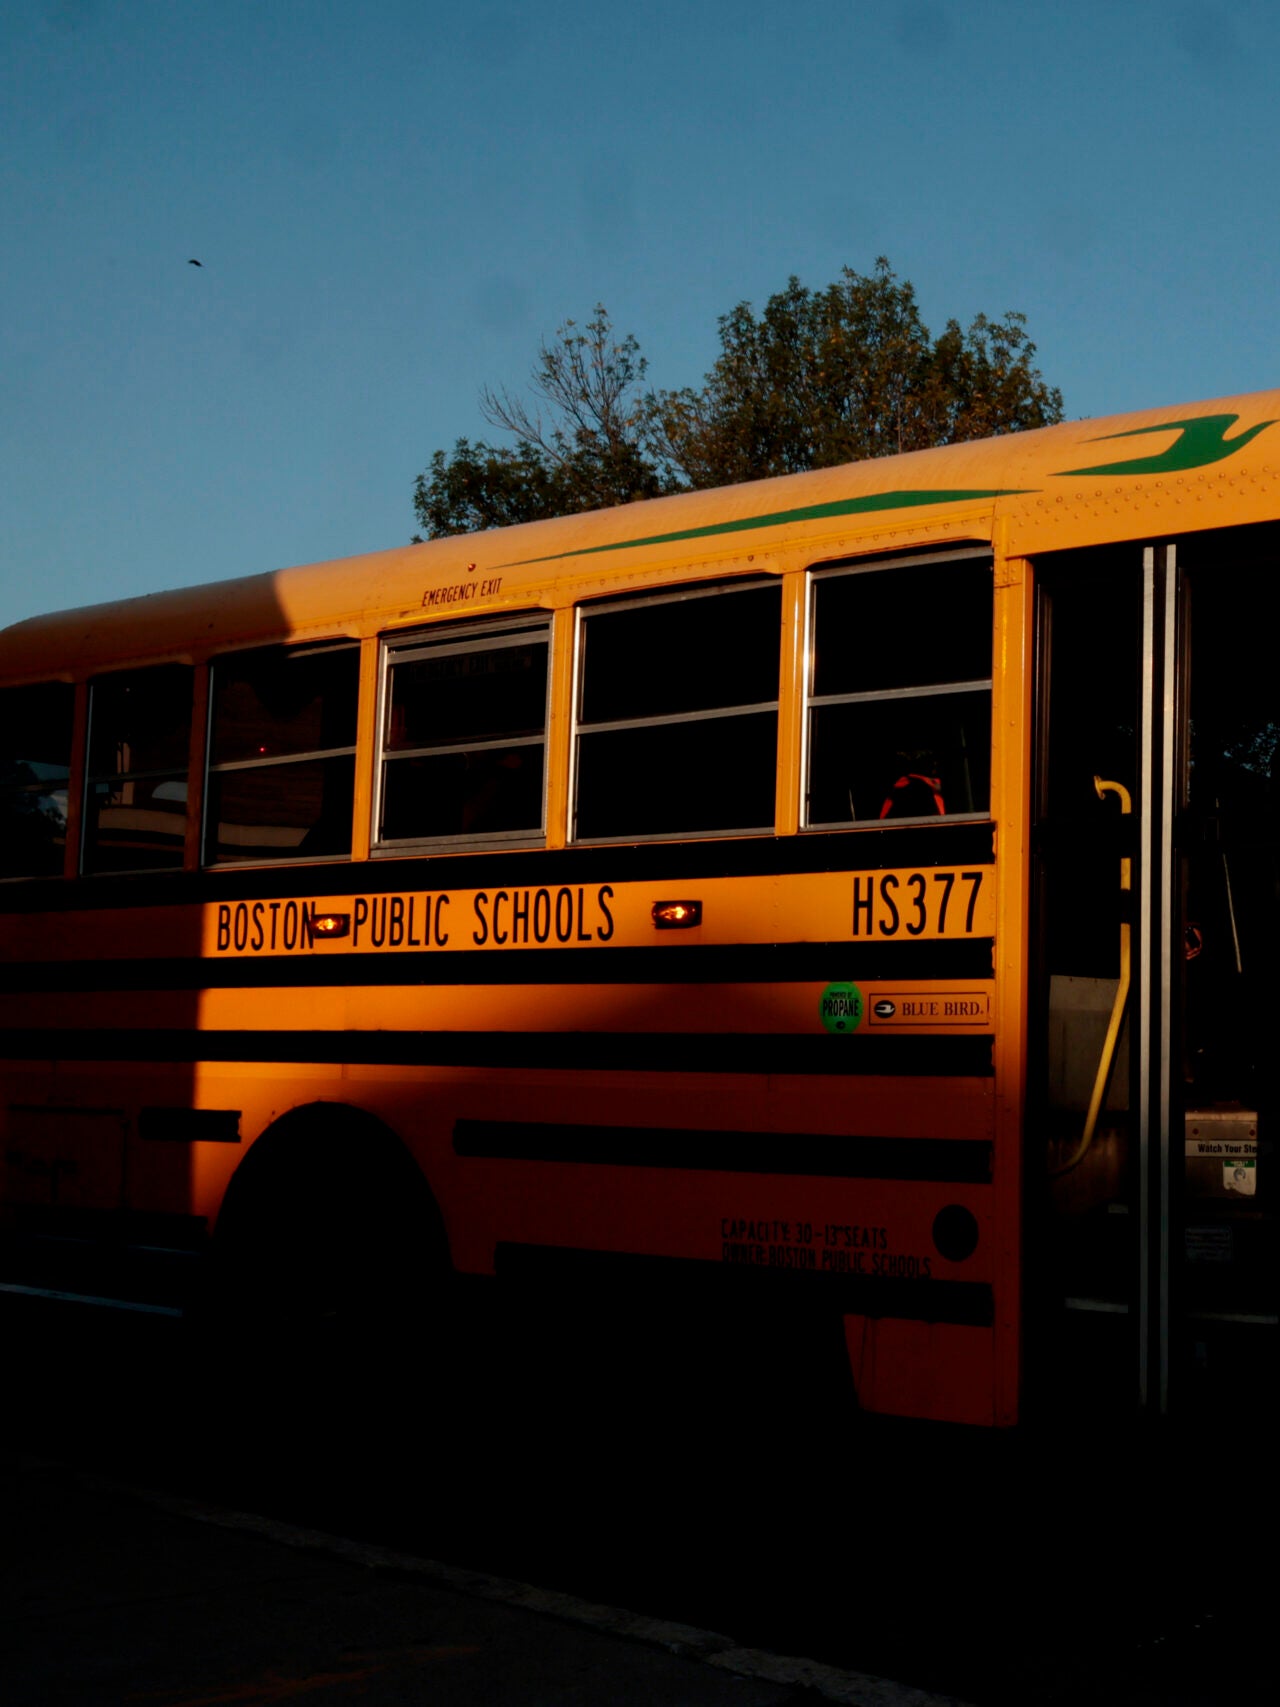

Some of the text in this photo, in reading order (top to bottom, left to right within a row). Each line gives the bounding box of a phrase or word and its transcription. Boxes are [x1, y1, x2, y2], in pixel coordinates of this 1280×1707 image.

[421, 577, 502, 607] EMERGENCY EXIT
[217, 885, 614, 951] BOSTON PUBLIC SCHOOLS
[853, 872, 982, 935] HS377
[822, 999, 860, 1017] PROPANE
[902, 1001, 939, 1016] BLUE
[1198, 1143, 1259, 1153] Watch Your Ste
[821, 1248, 867, 1273] PUBLIC
[871, 1253, 932, 1279] SCHOOLS
